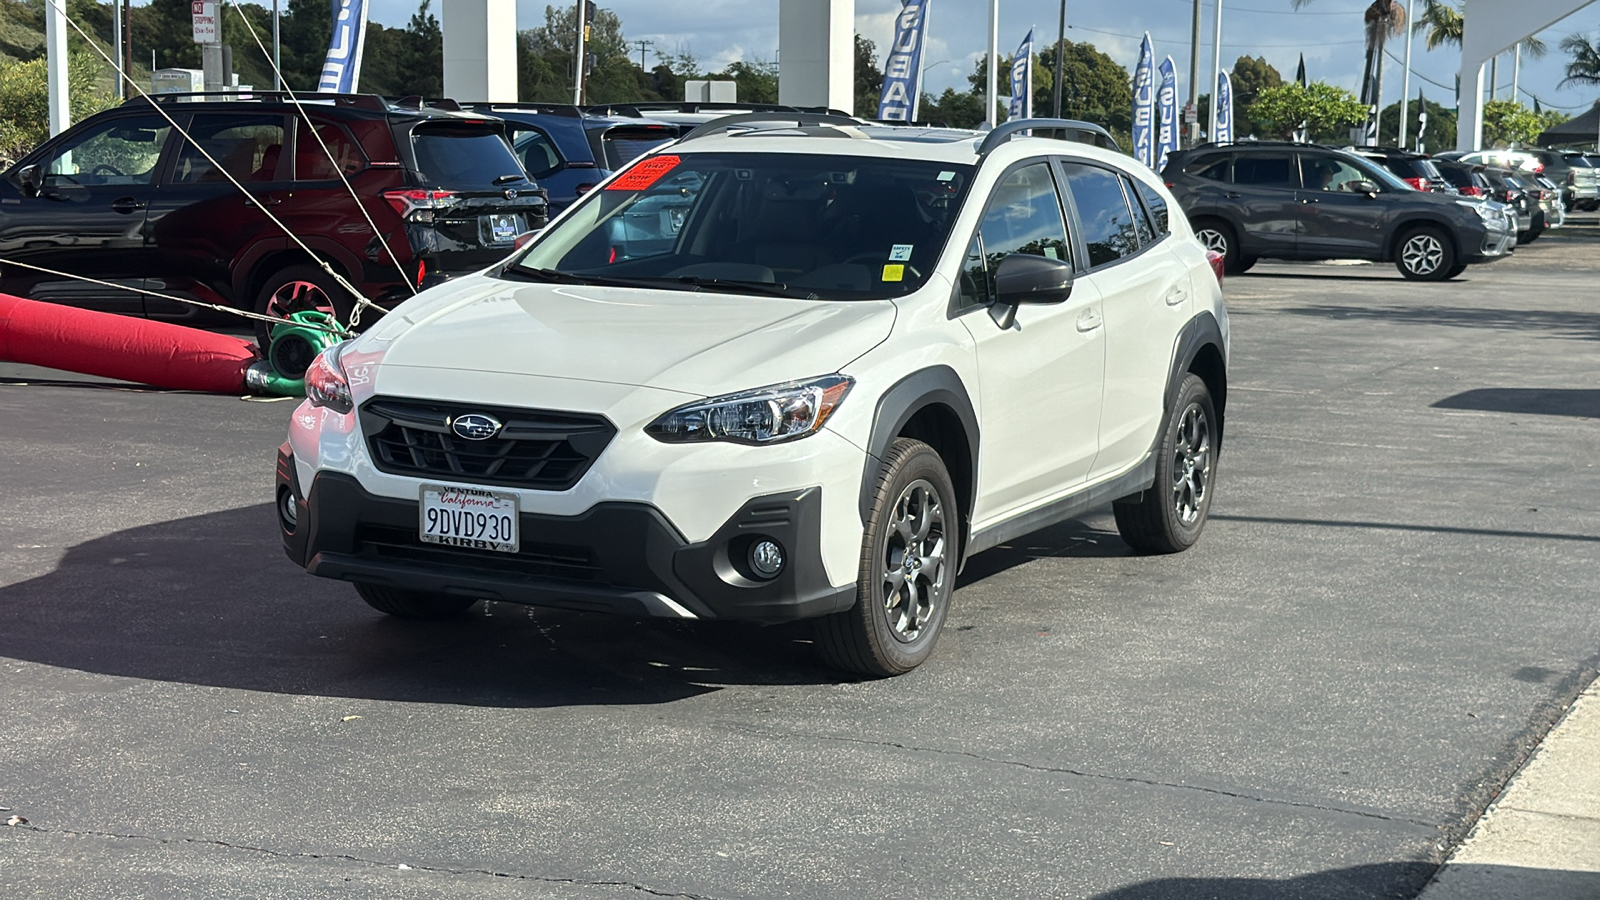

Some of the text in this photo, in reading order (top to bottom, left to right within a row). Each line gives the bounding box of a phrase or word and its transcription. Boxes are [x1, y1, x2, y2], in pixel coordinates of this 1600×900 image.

[194, 3, 203, 13] NO
[194, 16, 214, 24] STOPPING
[443, 486, 494, 498] VENTURA
[441, 491, 500, 509] California
[427, 507, 512, 541] 9DVD930
[438, 536, 500, 551] KIRBY
